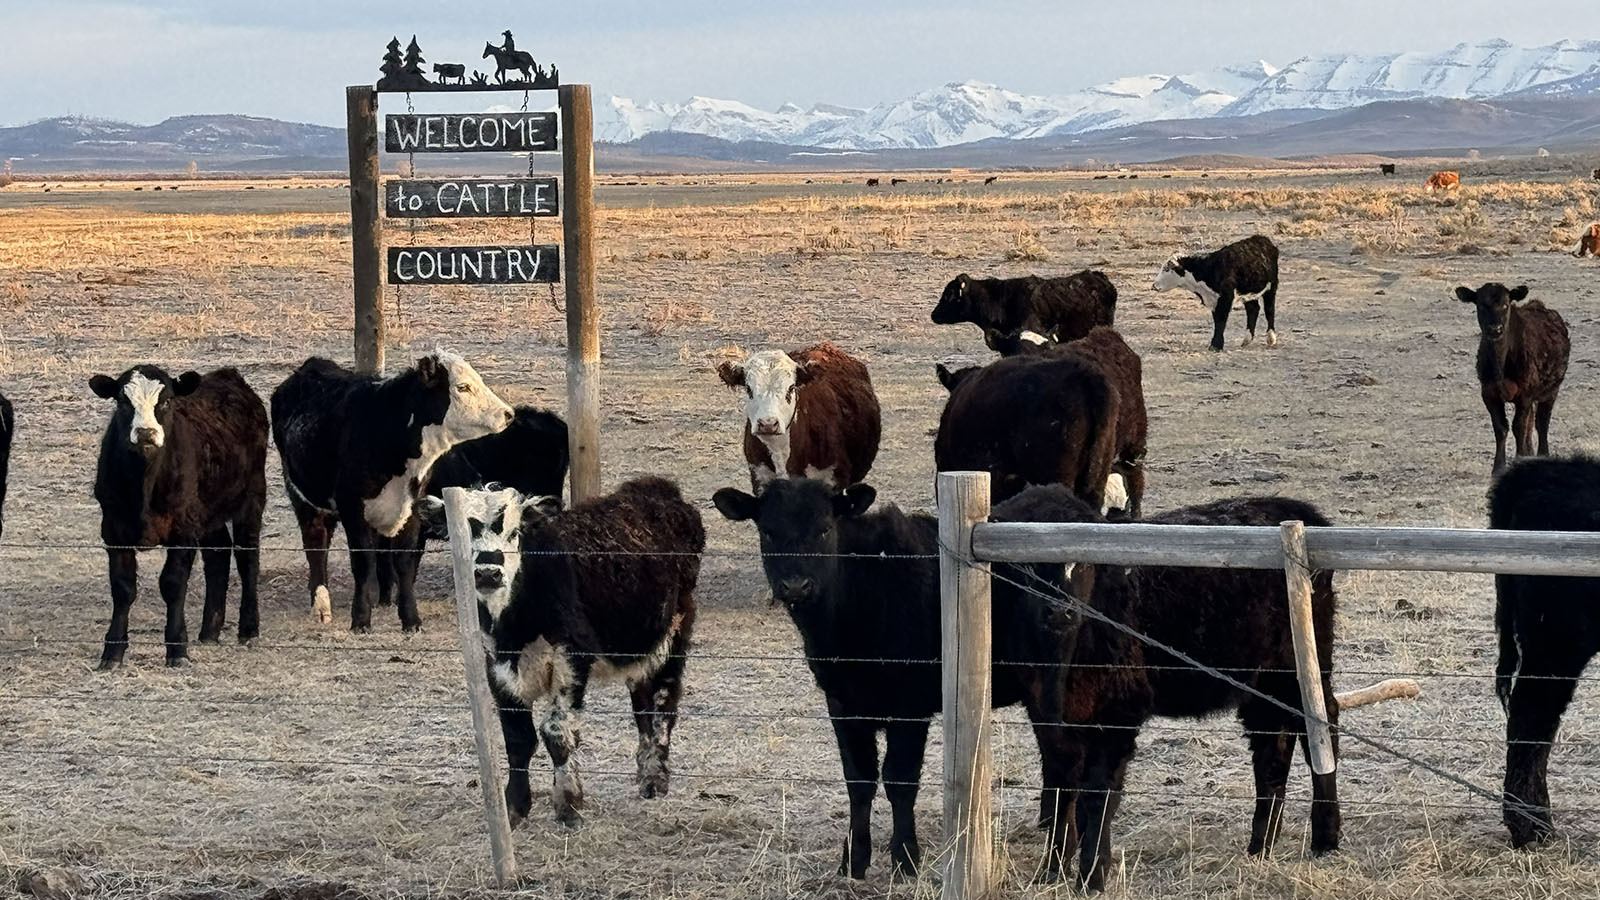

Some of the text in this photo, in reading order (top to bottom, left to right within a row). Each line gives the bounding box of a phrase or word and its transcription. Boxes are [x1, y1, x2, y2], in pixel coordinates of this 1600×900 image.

[393, 116, 546, 149] WELCOME
[394, 183, 550, 213] to CATTLE
[396, 249, 541, 281] COUNTRY
